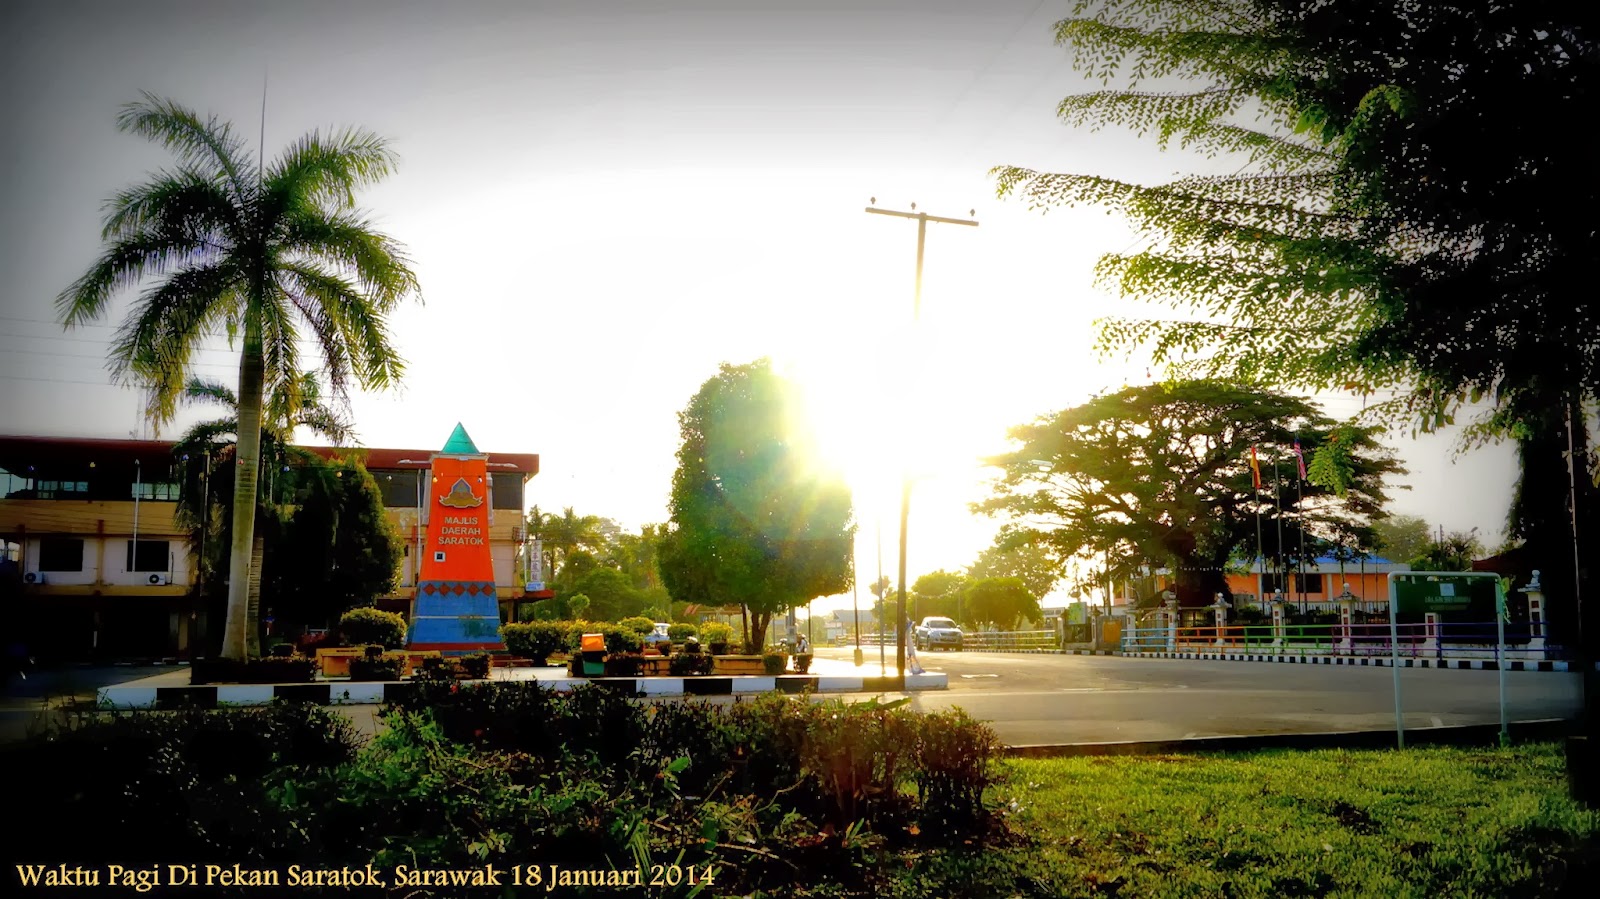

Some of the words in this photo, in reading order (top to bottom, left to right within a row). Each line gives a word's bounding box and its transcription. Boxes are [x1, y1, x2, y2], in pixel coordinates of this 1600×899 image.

[444, 516, 478, 525] MAJLIS
[441, 526, 481, 535] DAERAH
[438, 536, 484, 545] SARATOK
